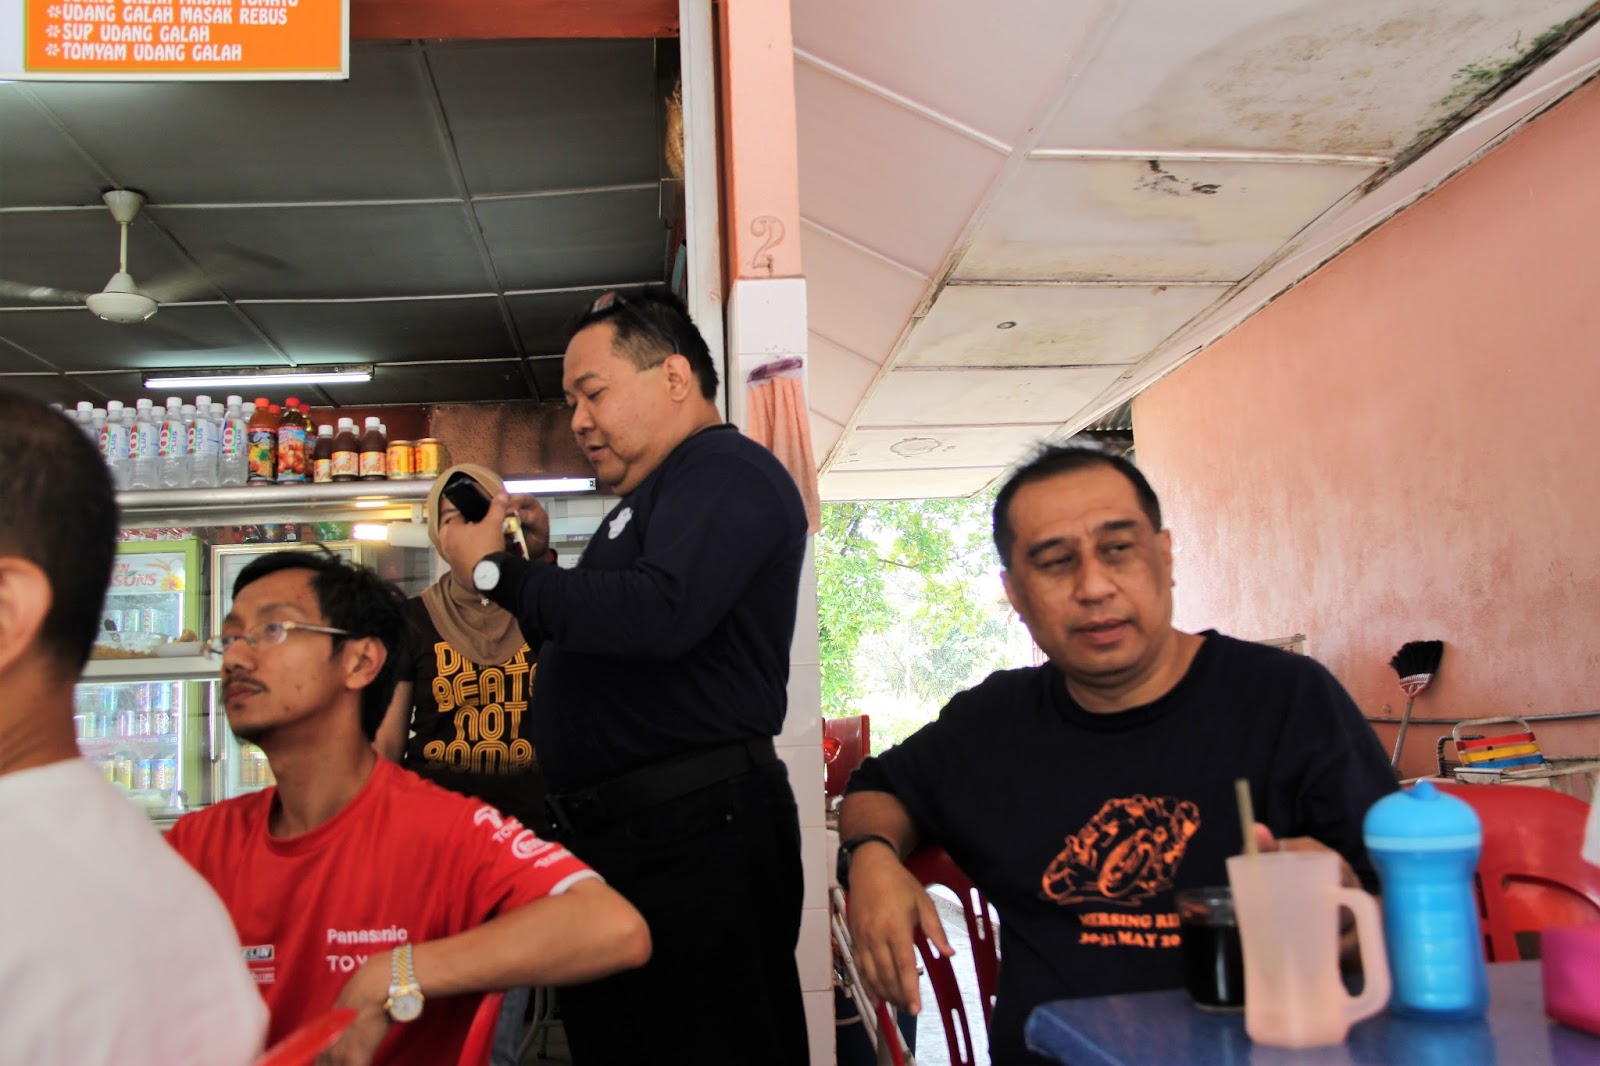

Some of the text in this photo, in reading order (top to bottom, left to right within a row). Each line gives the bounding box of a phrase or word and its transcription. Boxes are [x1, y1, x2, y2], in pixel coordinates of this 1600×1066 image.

[62, 4, 116, 22] UDANG
[123, 5, 174, 23] GALAH
[180, 6, 233, 24] MASAK
[239, 7, 288, 25] REBUS
[62, 23, 210, 43] SUP UDANG GALAH
[62, 42, 242, 61] TOMYAM UDANG GALAH
[750, 215, 785, 273] 2
[109, 434, 118, 456] PLUS
[140, 432, 148, 454] PLUS
[170, 431, 179, 453] PLUS
[454, 703, 528, 741] NOT
[1118, 930, 1157, 948] MAY
[326, 955, 368, 972] TOY
